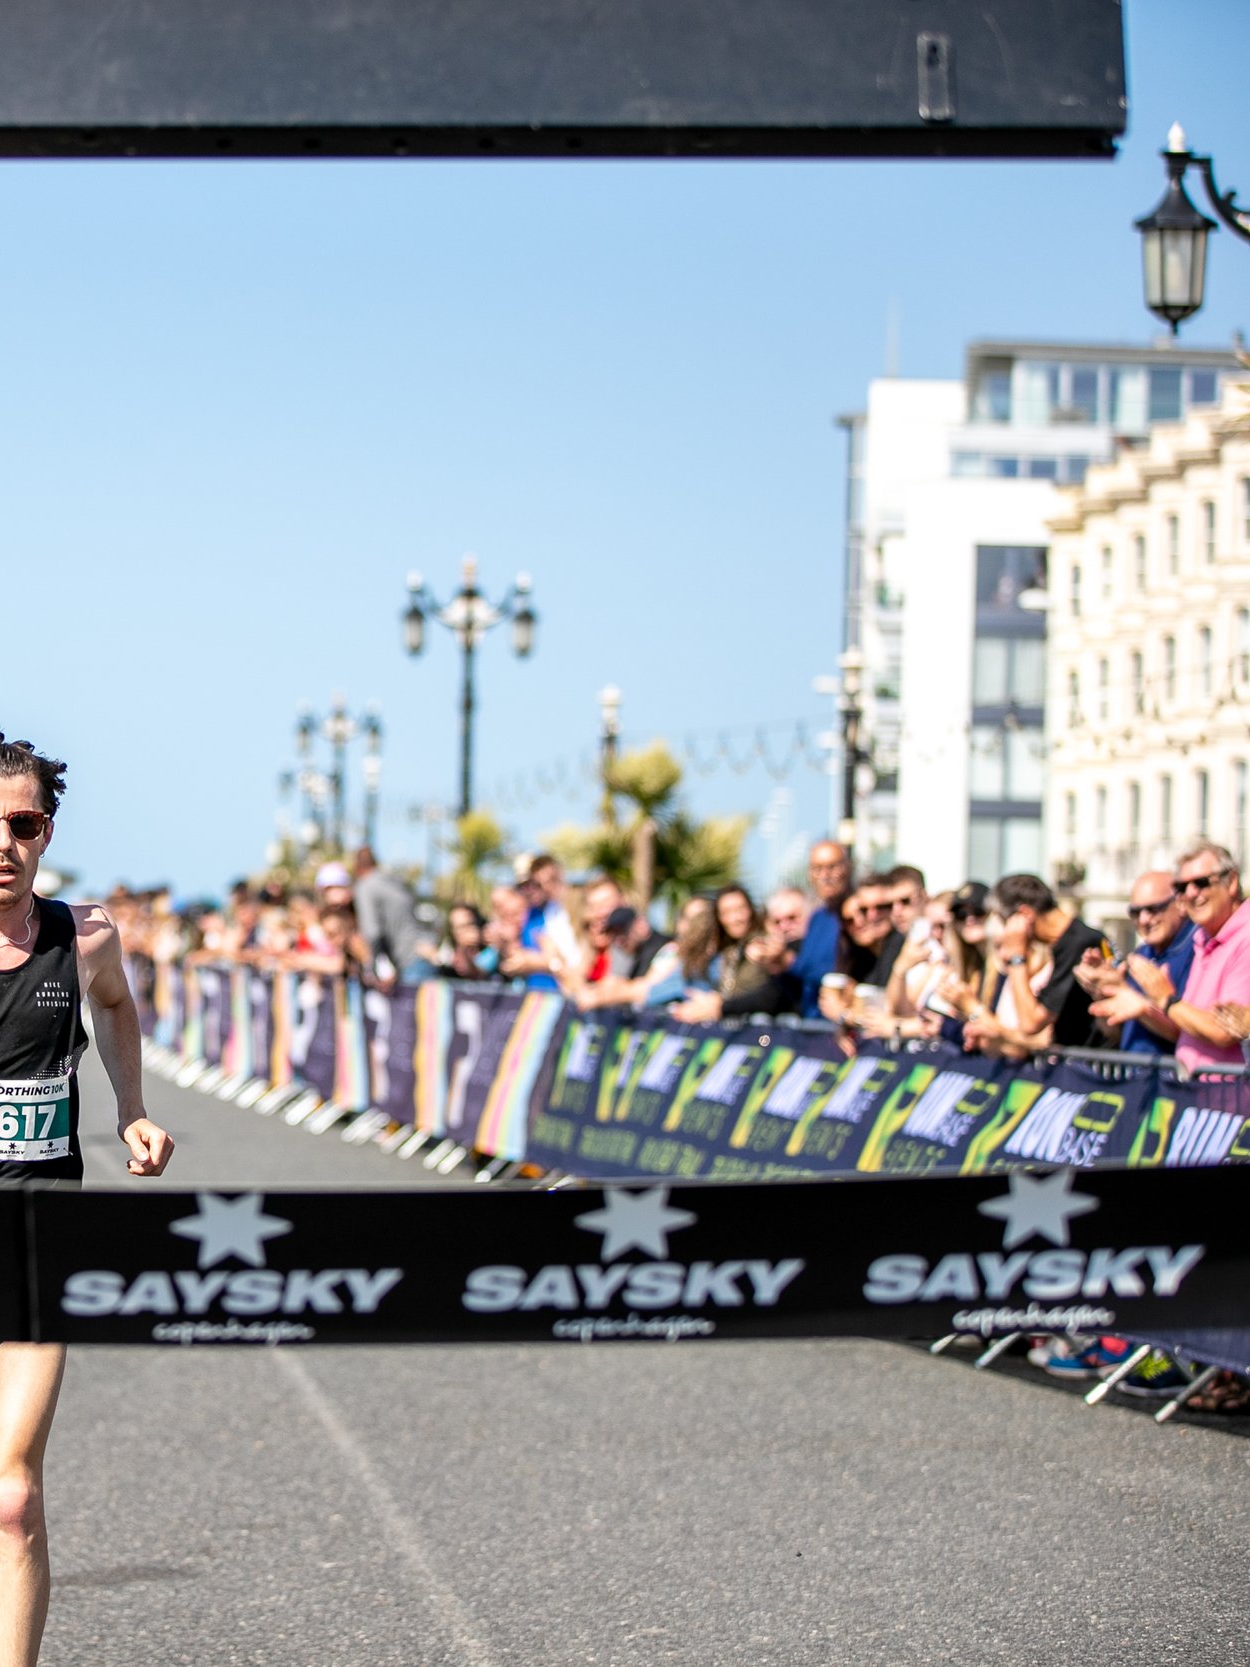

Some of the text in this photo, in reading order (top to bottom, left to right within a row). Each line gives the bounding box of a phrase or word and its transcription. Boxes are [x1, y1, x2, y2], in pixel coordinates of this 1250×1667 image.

[51, 1083, 66, 1096] 10K
[60, 1267, 405, 1317] SAYSKY
[461, 1257, 805, 1313] SAYSKY
[862, 1244, 1206, 1305] SAYSKY
